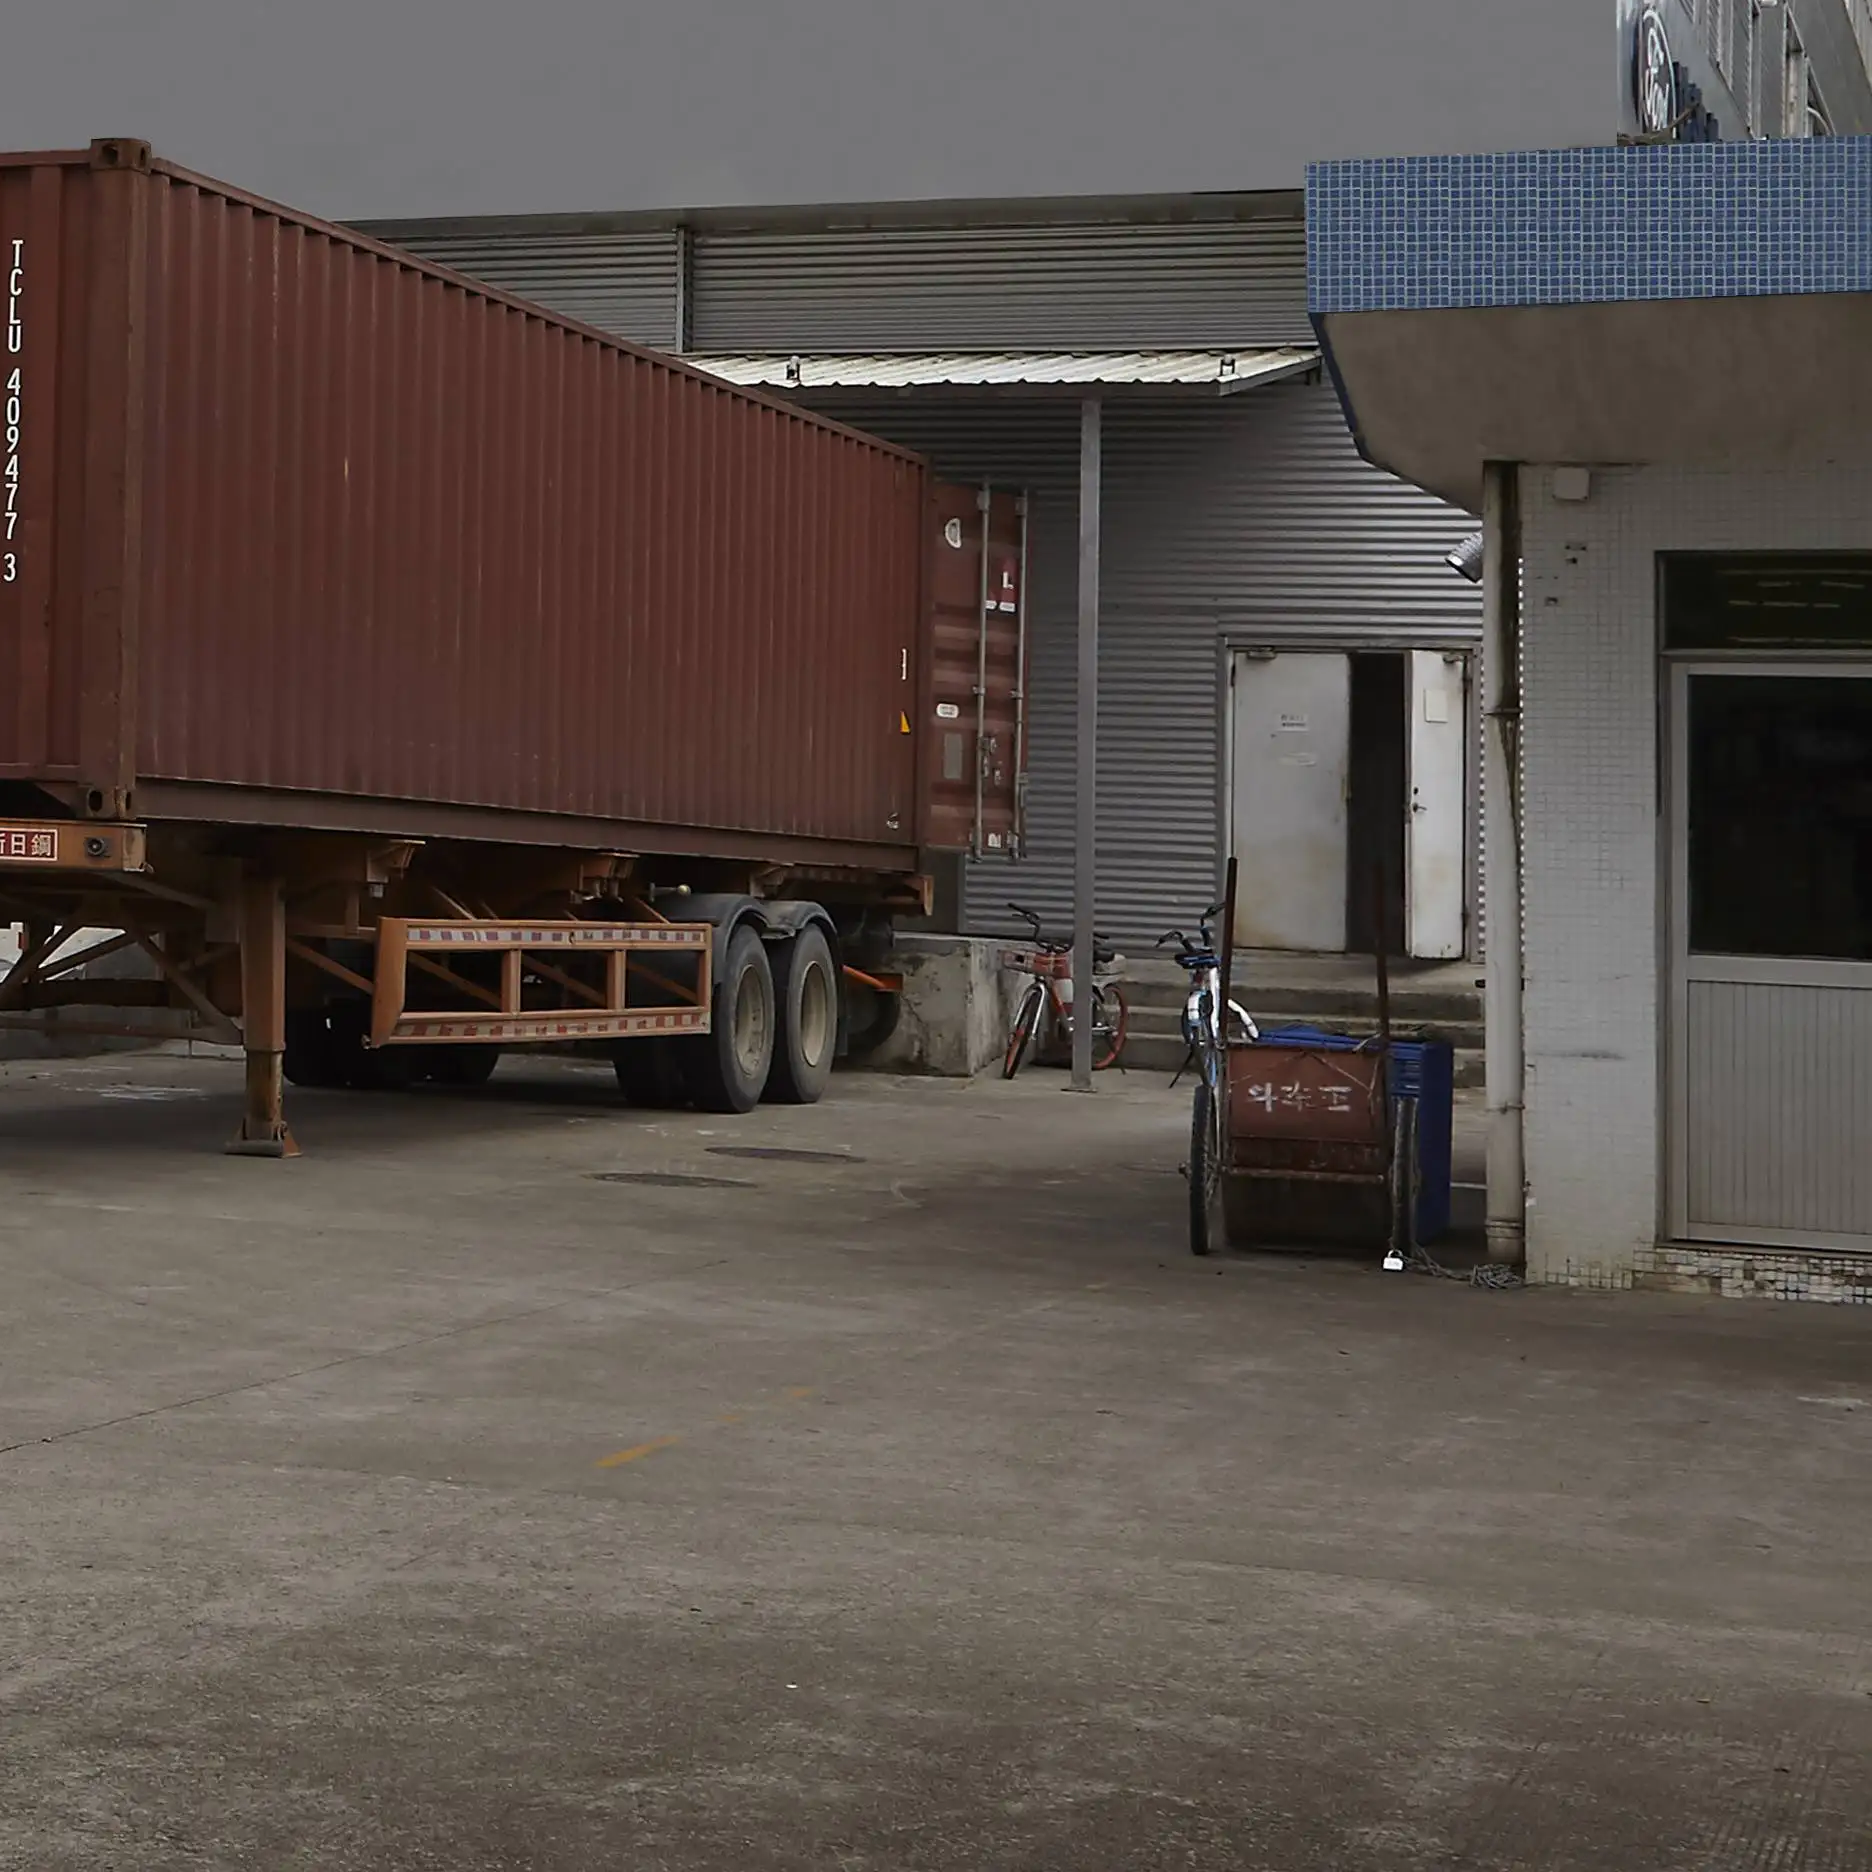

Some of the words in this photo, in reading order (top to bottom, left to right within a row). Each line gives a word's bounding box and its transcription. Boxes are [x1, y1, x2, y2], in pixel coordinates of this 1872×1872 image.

[8, 239, 24, 353] TCLU
[5, 368, 21, 540] 409477
[3, 553, 16, 581] 3
